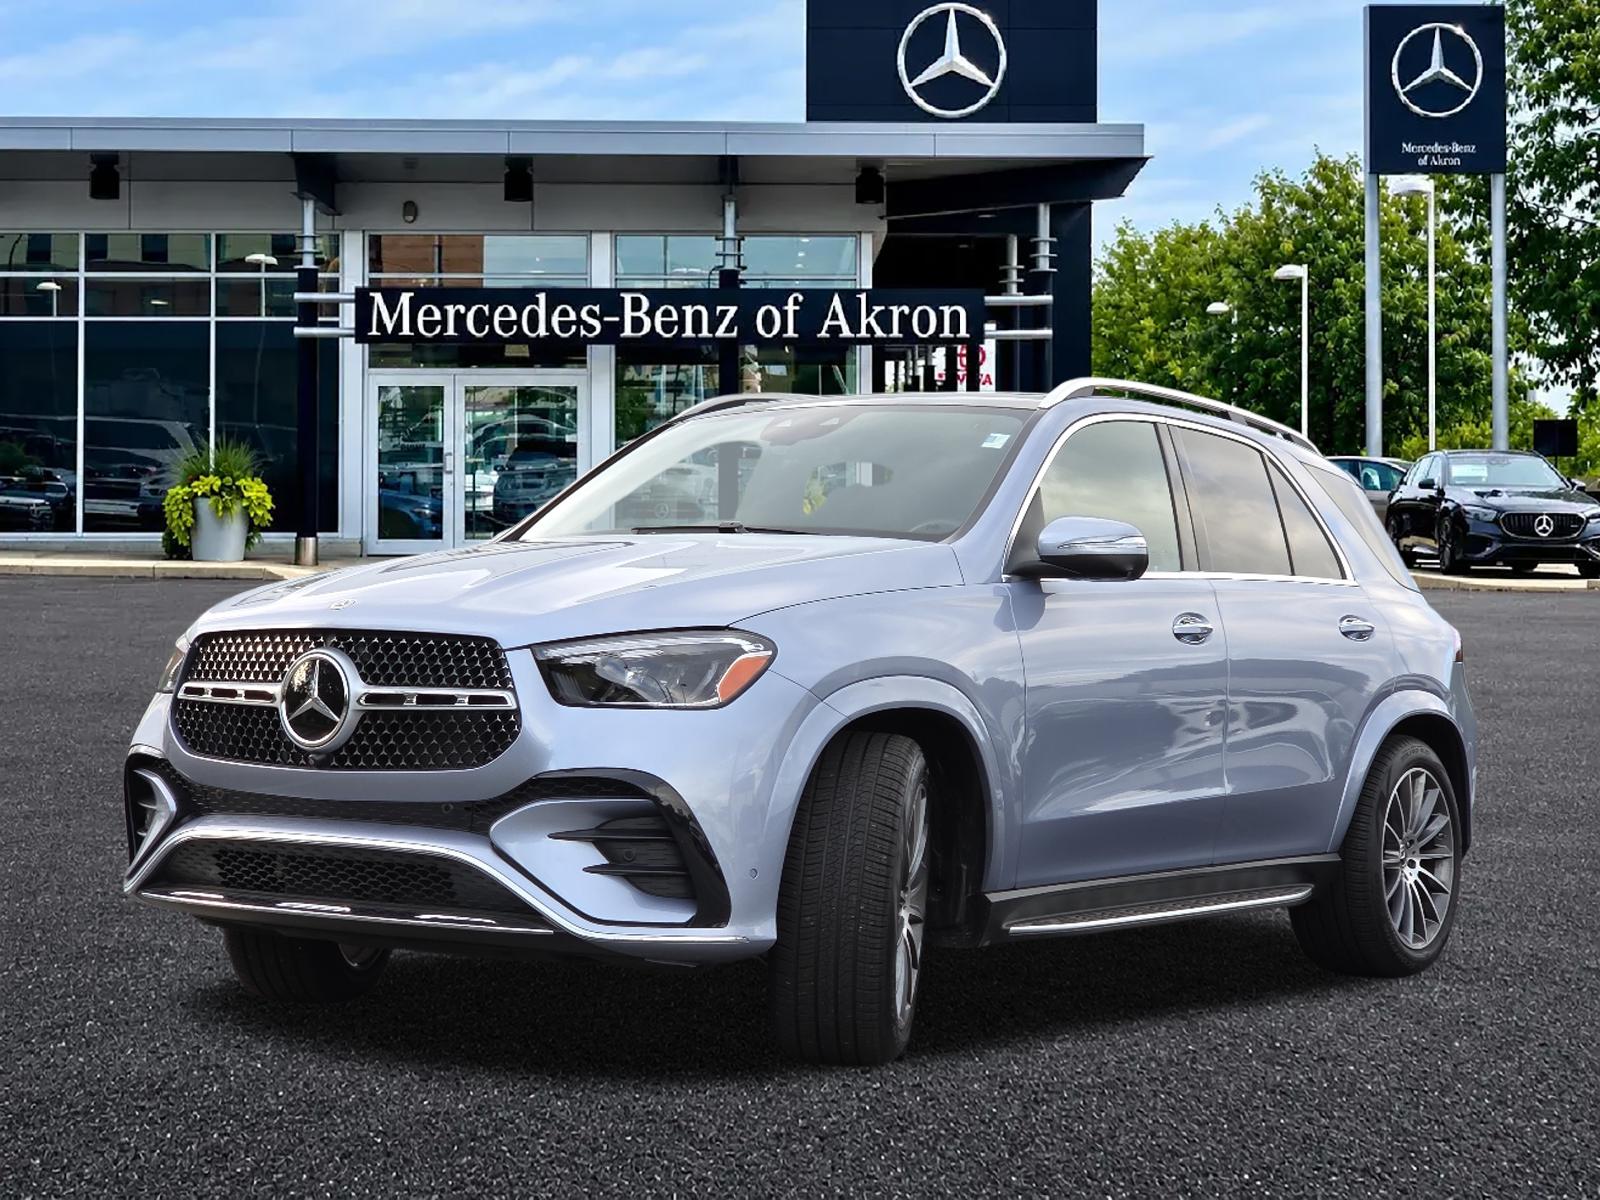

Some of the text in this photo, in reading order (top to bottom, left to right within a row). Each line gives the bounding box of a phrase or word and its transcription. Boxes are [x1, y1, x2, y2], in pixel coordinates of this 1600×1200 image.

[1401, 141, 1477, 154] Mercedes-Benz
[1417, 154, 1461, 166] of Akron
[367, 292, 970, 338] Mercedes-Benz of Akron
